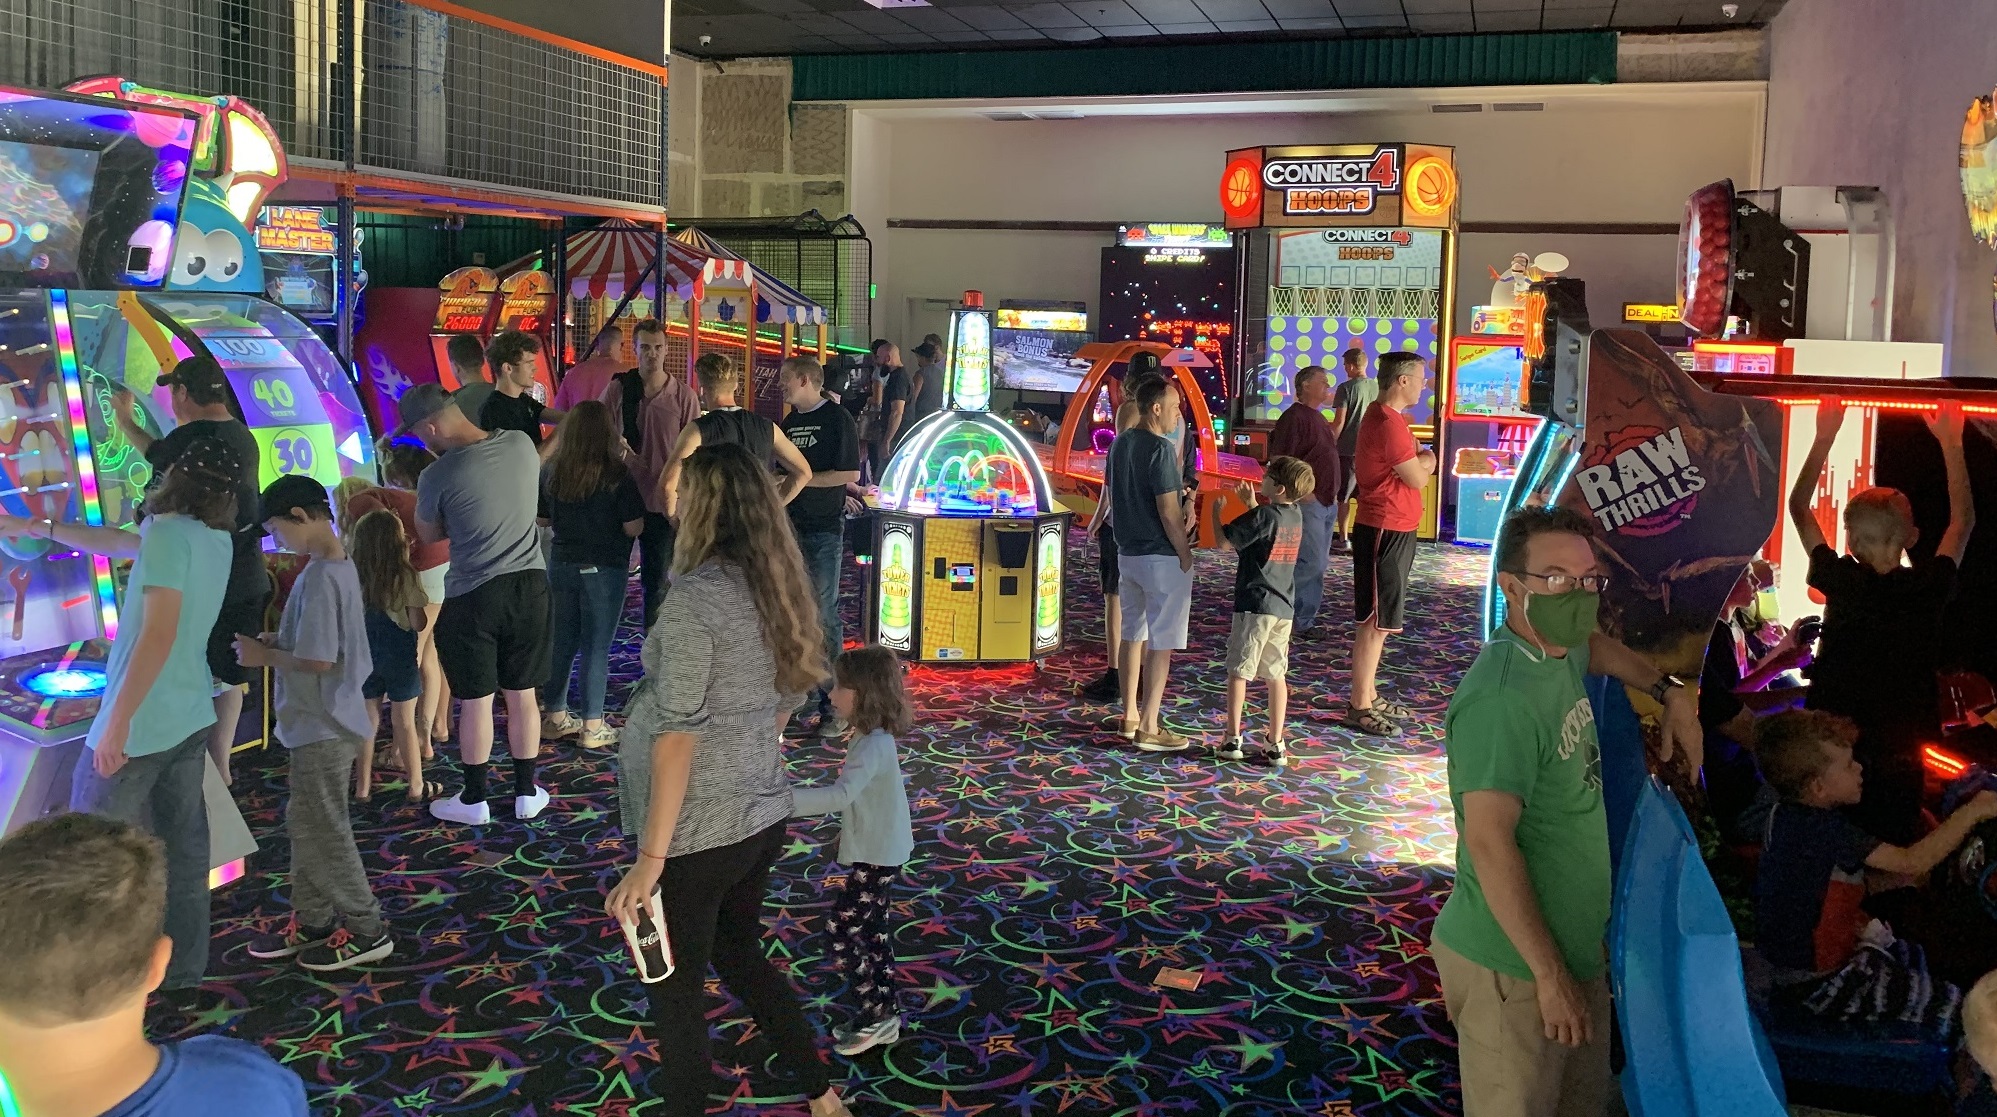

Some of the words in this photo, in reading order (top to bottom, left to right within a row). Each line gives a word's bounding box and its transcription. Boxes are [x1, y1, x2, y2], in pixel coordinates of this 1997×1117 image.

[1265, 162, 1370, 183] CONNECT
[1368, 152, 1396, 188] 4
[1289, 190, 1370, 211] HOOPS
[271, 207, 320, 230] LANE
[261, 227, 334, 251] MASTER
[1324, 230, 1393, 242] CONNECT
[1391, 230, 1411, 246] 4
[1161, 247, 1200, 255] CREDITS
[1338, 246, 1394, 260] HOOPS
[1627, 308, 1659, 318] DEAL
[444, 316, 484, 331] 26000
[212, 339, 266, 356] 100
[1015, 335, 1054, 349] SALMON
[1017, 344, 1048, 358] BONUS
[253, 378, 295, 409] 40
[273, 436, 313, 474] 30
[1575, 426, 1691, 510] RAW
[1593, 465, 1707, 532] THRILLS
[882, 562, 911, 582] TOWER
[880, 581, 912, 598] TICKETS
